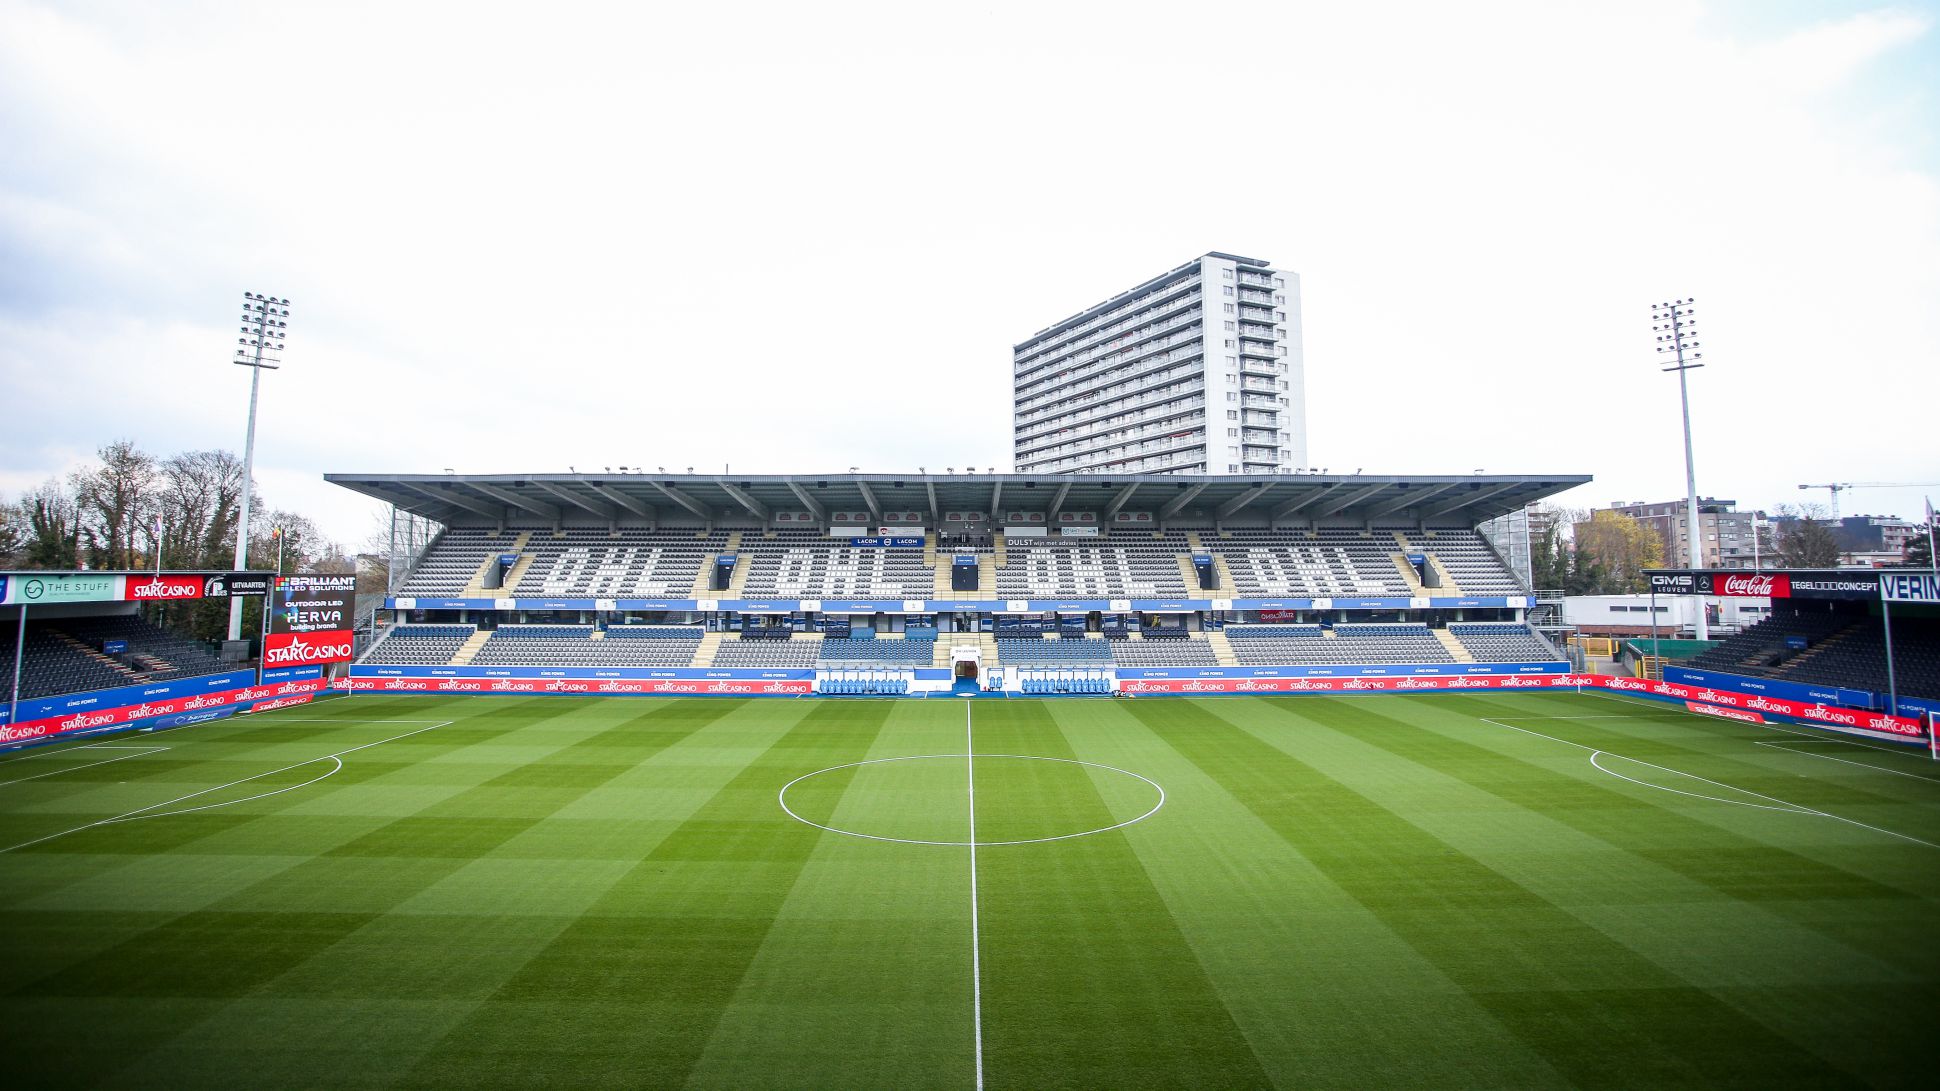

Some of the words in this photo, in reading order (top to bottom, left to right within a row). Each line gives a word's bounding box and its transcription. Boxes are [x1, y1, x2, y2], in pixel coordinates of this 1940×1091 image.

[290, 577, 355, 586] BRILLIANT
[1652, 576, 1692, 585] GMS
[76, 582, 109, 590] STUFF
[287, 611, 341, 622] HERVA
